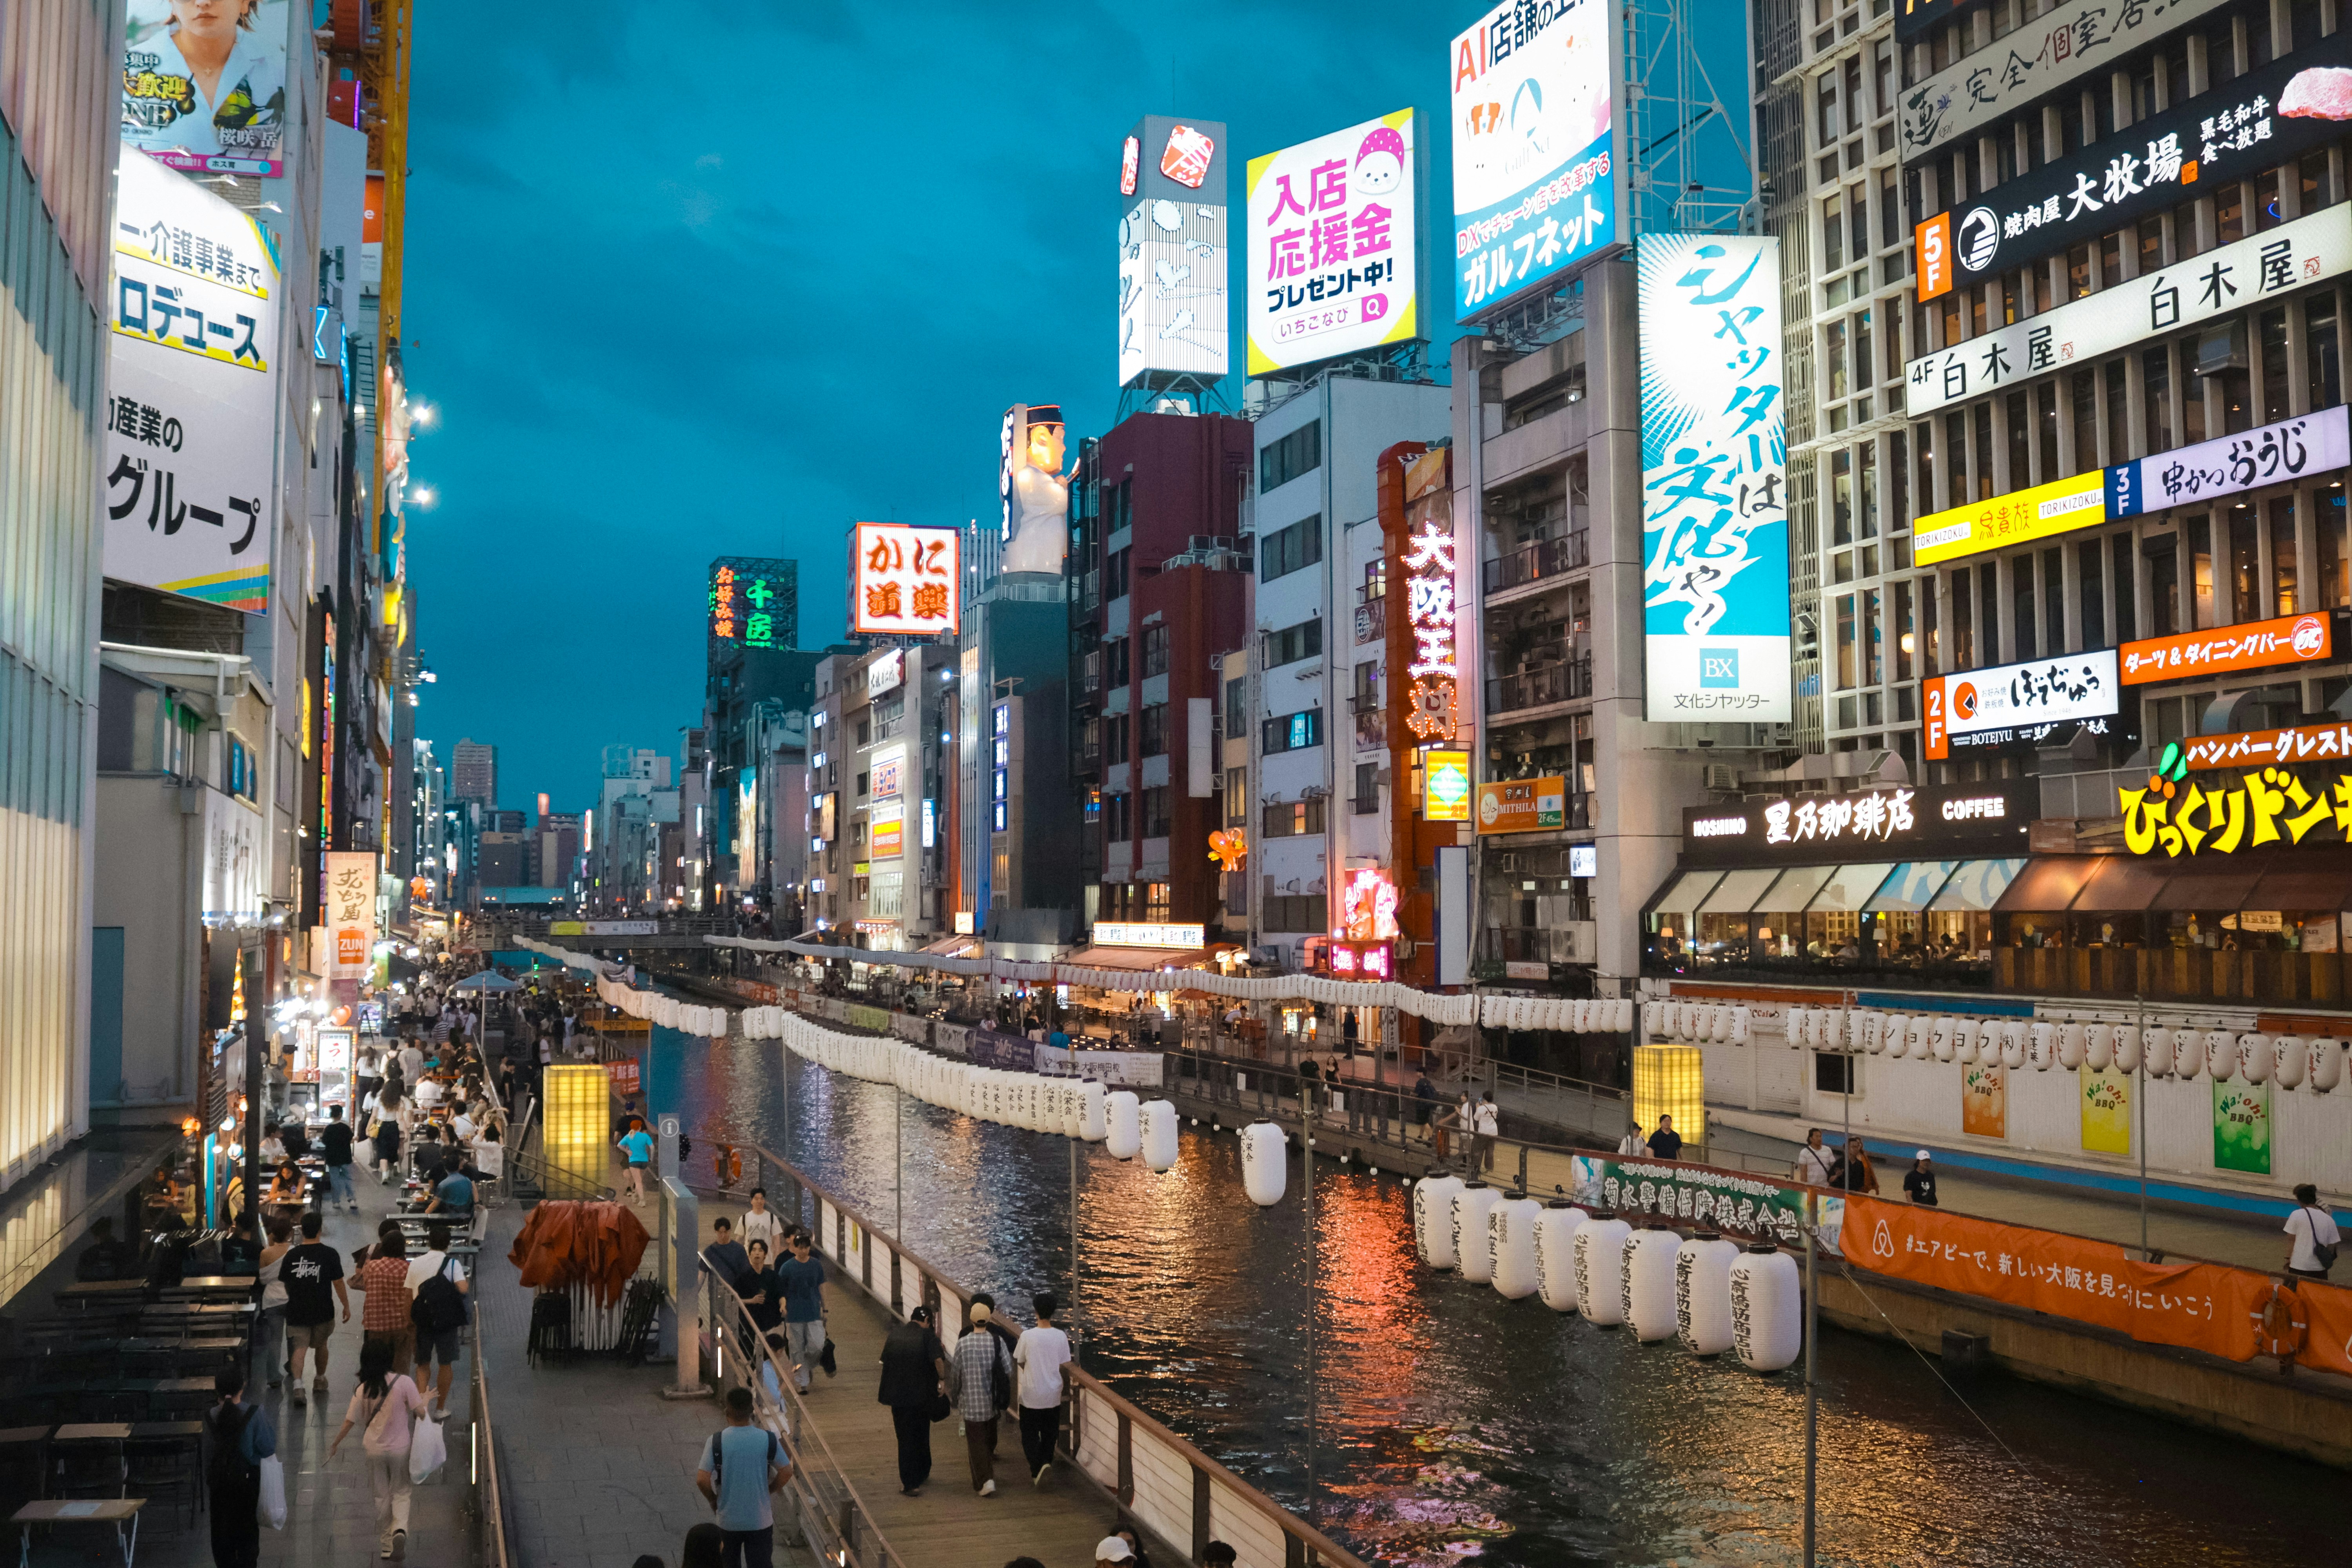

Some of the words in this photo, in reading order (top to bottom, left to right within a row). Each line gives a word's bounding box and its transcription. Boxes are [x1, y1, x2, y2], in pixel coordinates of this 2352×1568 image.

[2200, 95, 2270, 142] 黒毛和牛
[2200, 118, 2272, 164] 食べ放題
[1268, 159, 1347, 227] 入店
[1456, 151, 1610, 256] DXでチェーン店を改革する
[2004, 196, 2061, 239] 焼肉屋
[2065, 132, 2183, 221] 大牧場
[1268, 202, 1392, 283] 応援金
[1464, 195, 1605, 308] ガルフネット
[1924, 225, 1942, 292] 5F
[1268, 257, 1394, 313] プレゼント中!
[2151, 238, 2297, 331] 白木屋
[1281, 307, 1348, 338] いちごなび
[1912, 359, 1934, 386] 4F
[1944, 325, 2056, 401] 白木屋
[2162, 461, 2225, 498] 串かつ
[2229, 420, 2307, 486] おうじ
[107, 453, 261, 555] グループ
[2040, 492, 2097, 517] TORIKIZOKU
[2116, 467, 2130, 515] 3F
[866, 535, 948, 577] かに
[1915, 526, 1964, 548] TORIKIZOKU
[715, 566, 735, 637] お好み焼
[746, 579, 773, 640] 千房
[1401, 521, 1457, 740] 大阪王将
[2125, 648, 2166, 673] ダーツ
[2170, 648, 2181, 666] &
[2185, 630, 2291, 670] ダイニングバー
[1704, 659, 1733, 678] BX
[1982, 686, 2007, 697] お好み焼
[1929, 690, 1942, 749] 2F
[1984, 698, 2004, 709] 鉄板焼
[1971, 730, 2013, 745] BOTEJYU
[2187, 726, 2352, 764] ハンバーグレスト
[1451, 805, 1467, 817] 2F
[1499, 802, 1536, 814] MITHILA
[1538, 813, 1546, 823] 2F
[1693, 817, 1746, 837] HOSHINO
[1764, 789, 1915, 844] 星乃珈琲店
[1942, 797, 2005, 821] COFFEE
[340, 938, 363, 951] ZUN
[1046, 1086, 1054, 1113] 心栄会
[1063, 1088, 1073, 1115] 心栄会
[1078, 1094, 1086, 1122] 心栄会
[1975, 1085, 1993, 1096] BBQ
[2094, 1098, 2116, 1111] BBQ
[2229, 1112, 2254, 1126] BBQ
[1604, 1177, 1798, 1240] 菊水警備保障株式会社
[1730, 1268, 1754, 1361] 心斎橋筋商店街
